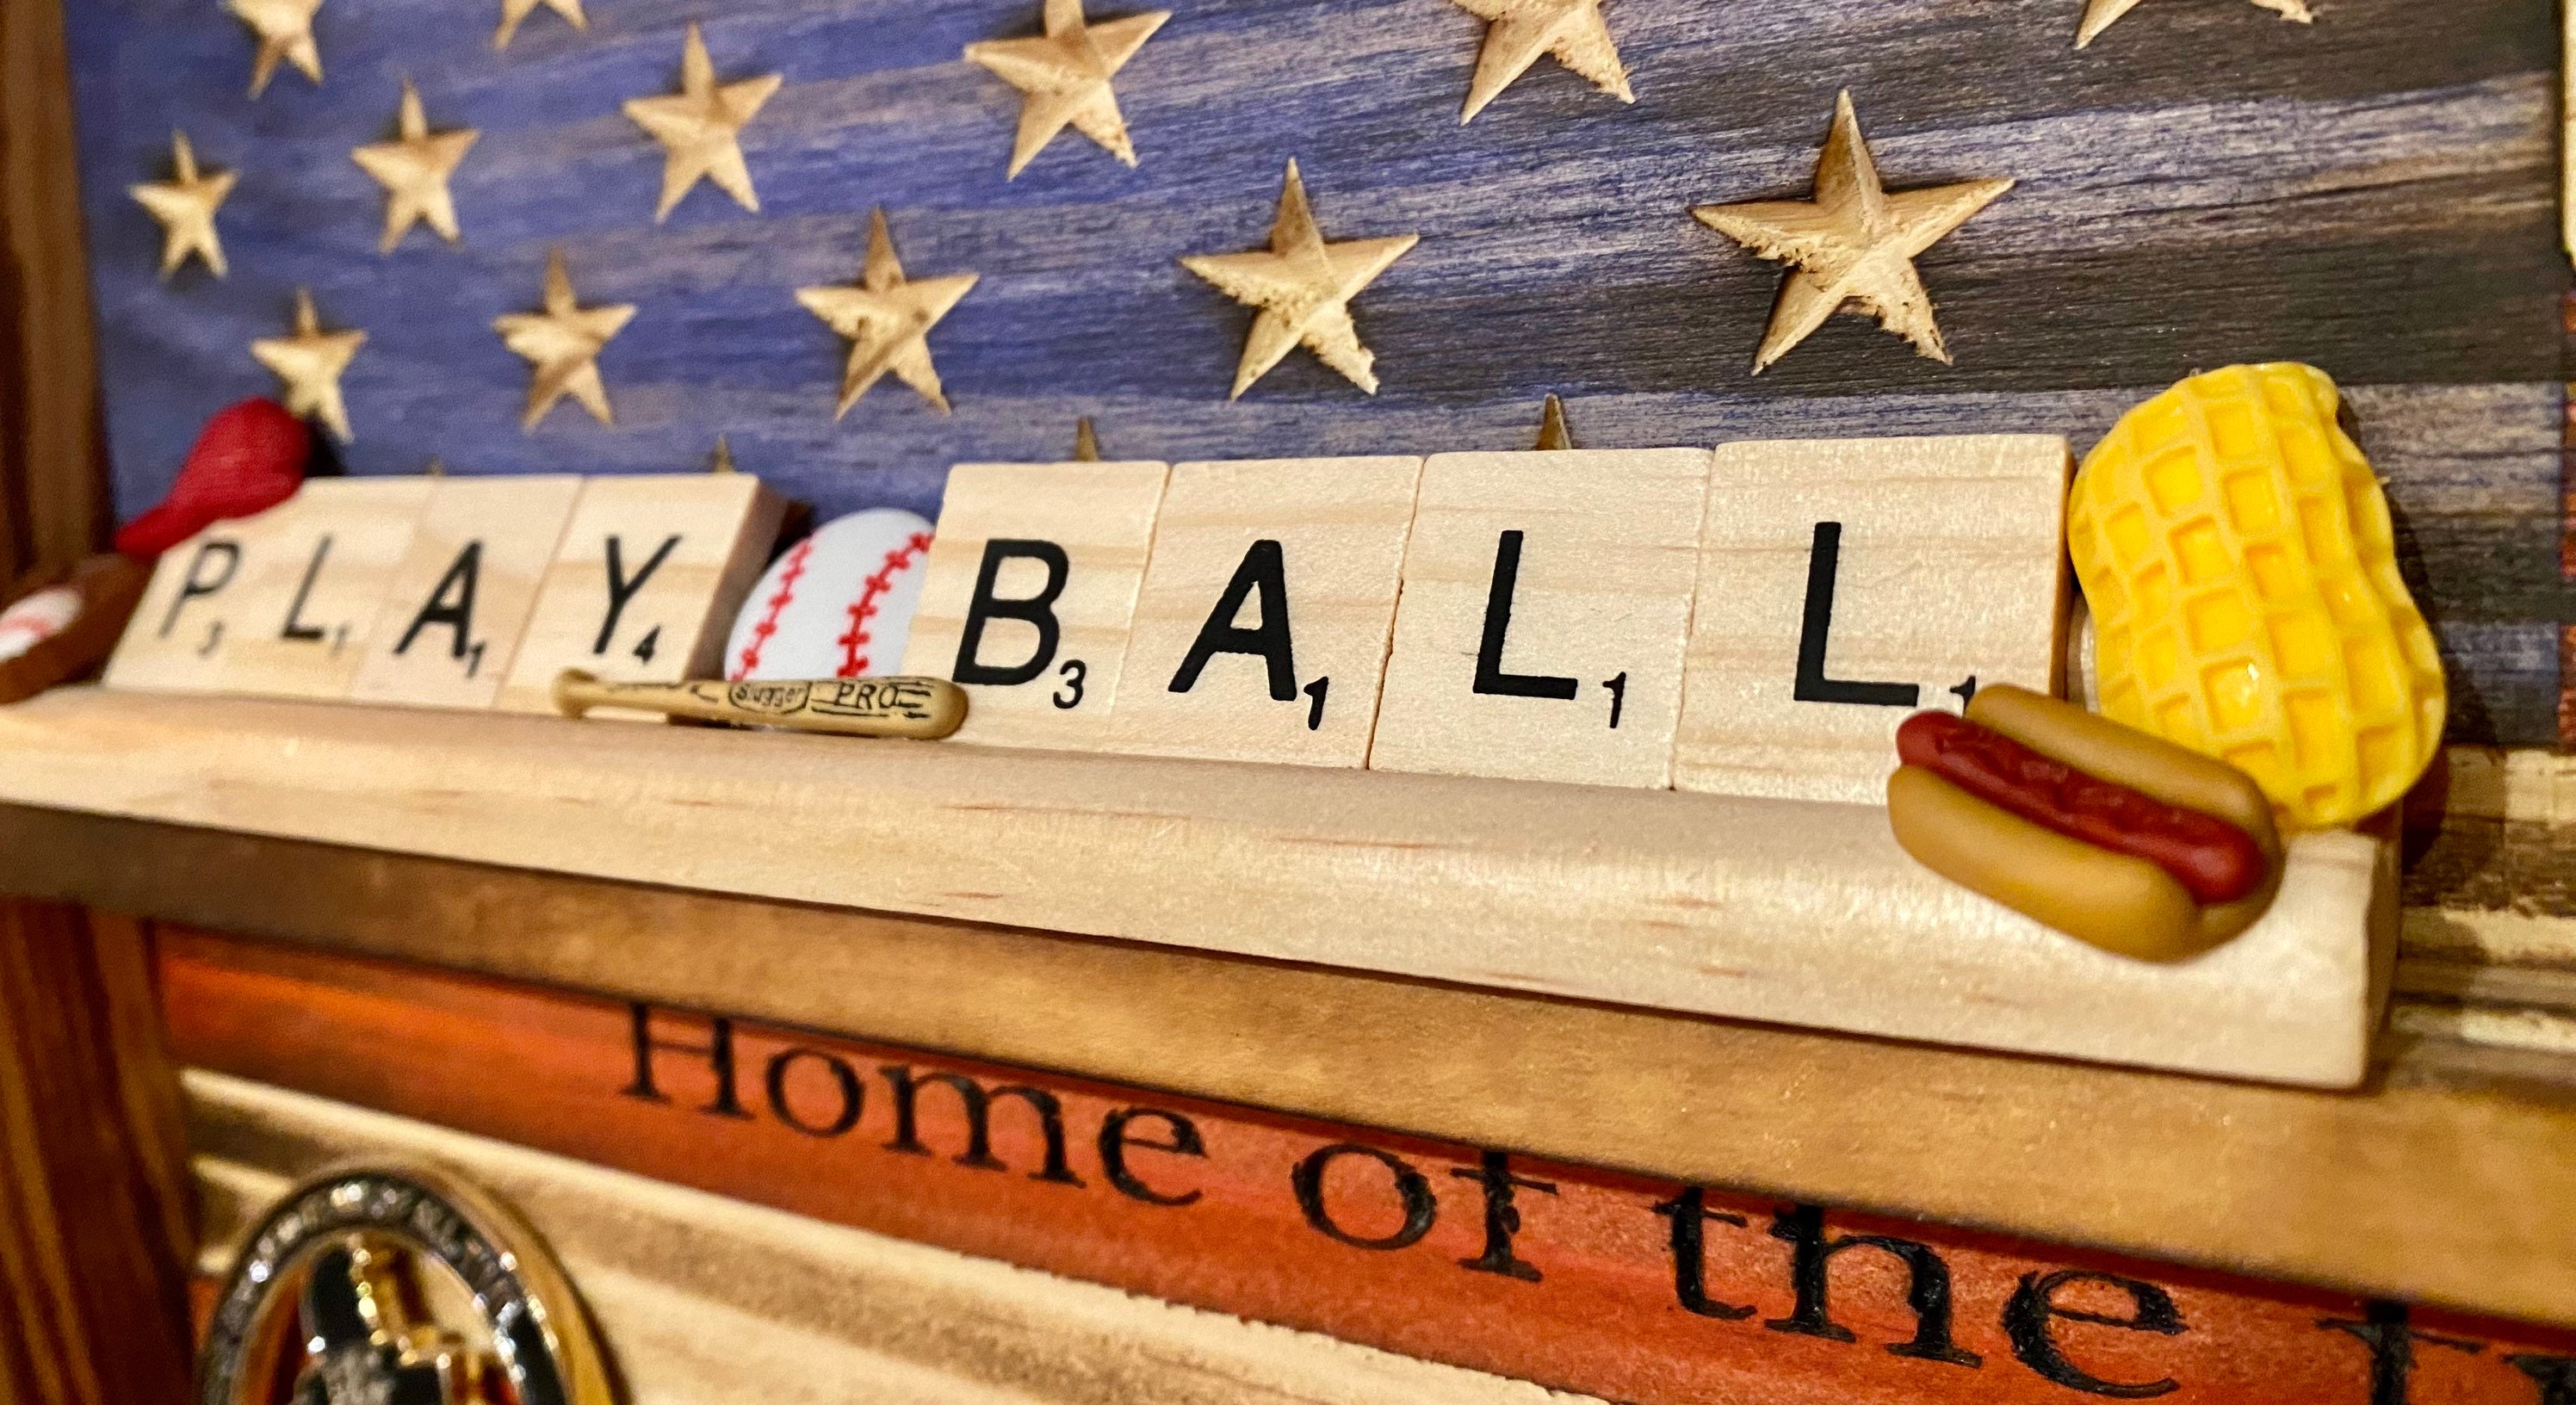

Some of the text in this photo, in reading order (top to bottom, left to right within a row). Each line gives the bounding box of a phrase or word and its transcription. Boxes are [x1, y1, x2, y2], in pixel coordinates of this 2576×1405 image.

[158, 521, 1920, 707] PLAY BALL
[834, 680, 899, 710] PRO
[1053, 659, 1088, 710] 3
[1303, 675, 1329, 731] 1
[1601, 672, 1627, 728] 1
[617, 1002, 1209, 1206] Home
[1291, 1142, 1560, 1283] of
[1652, 1185, 2189, 1399] the
